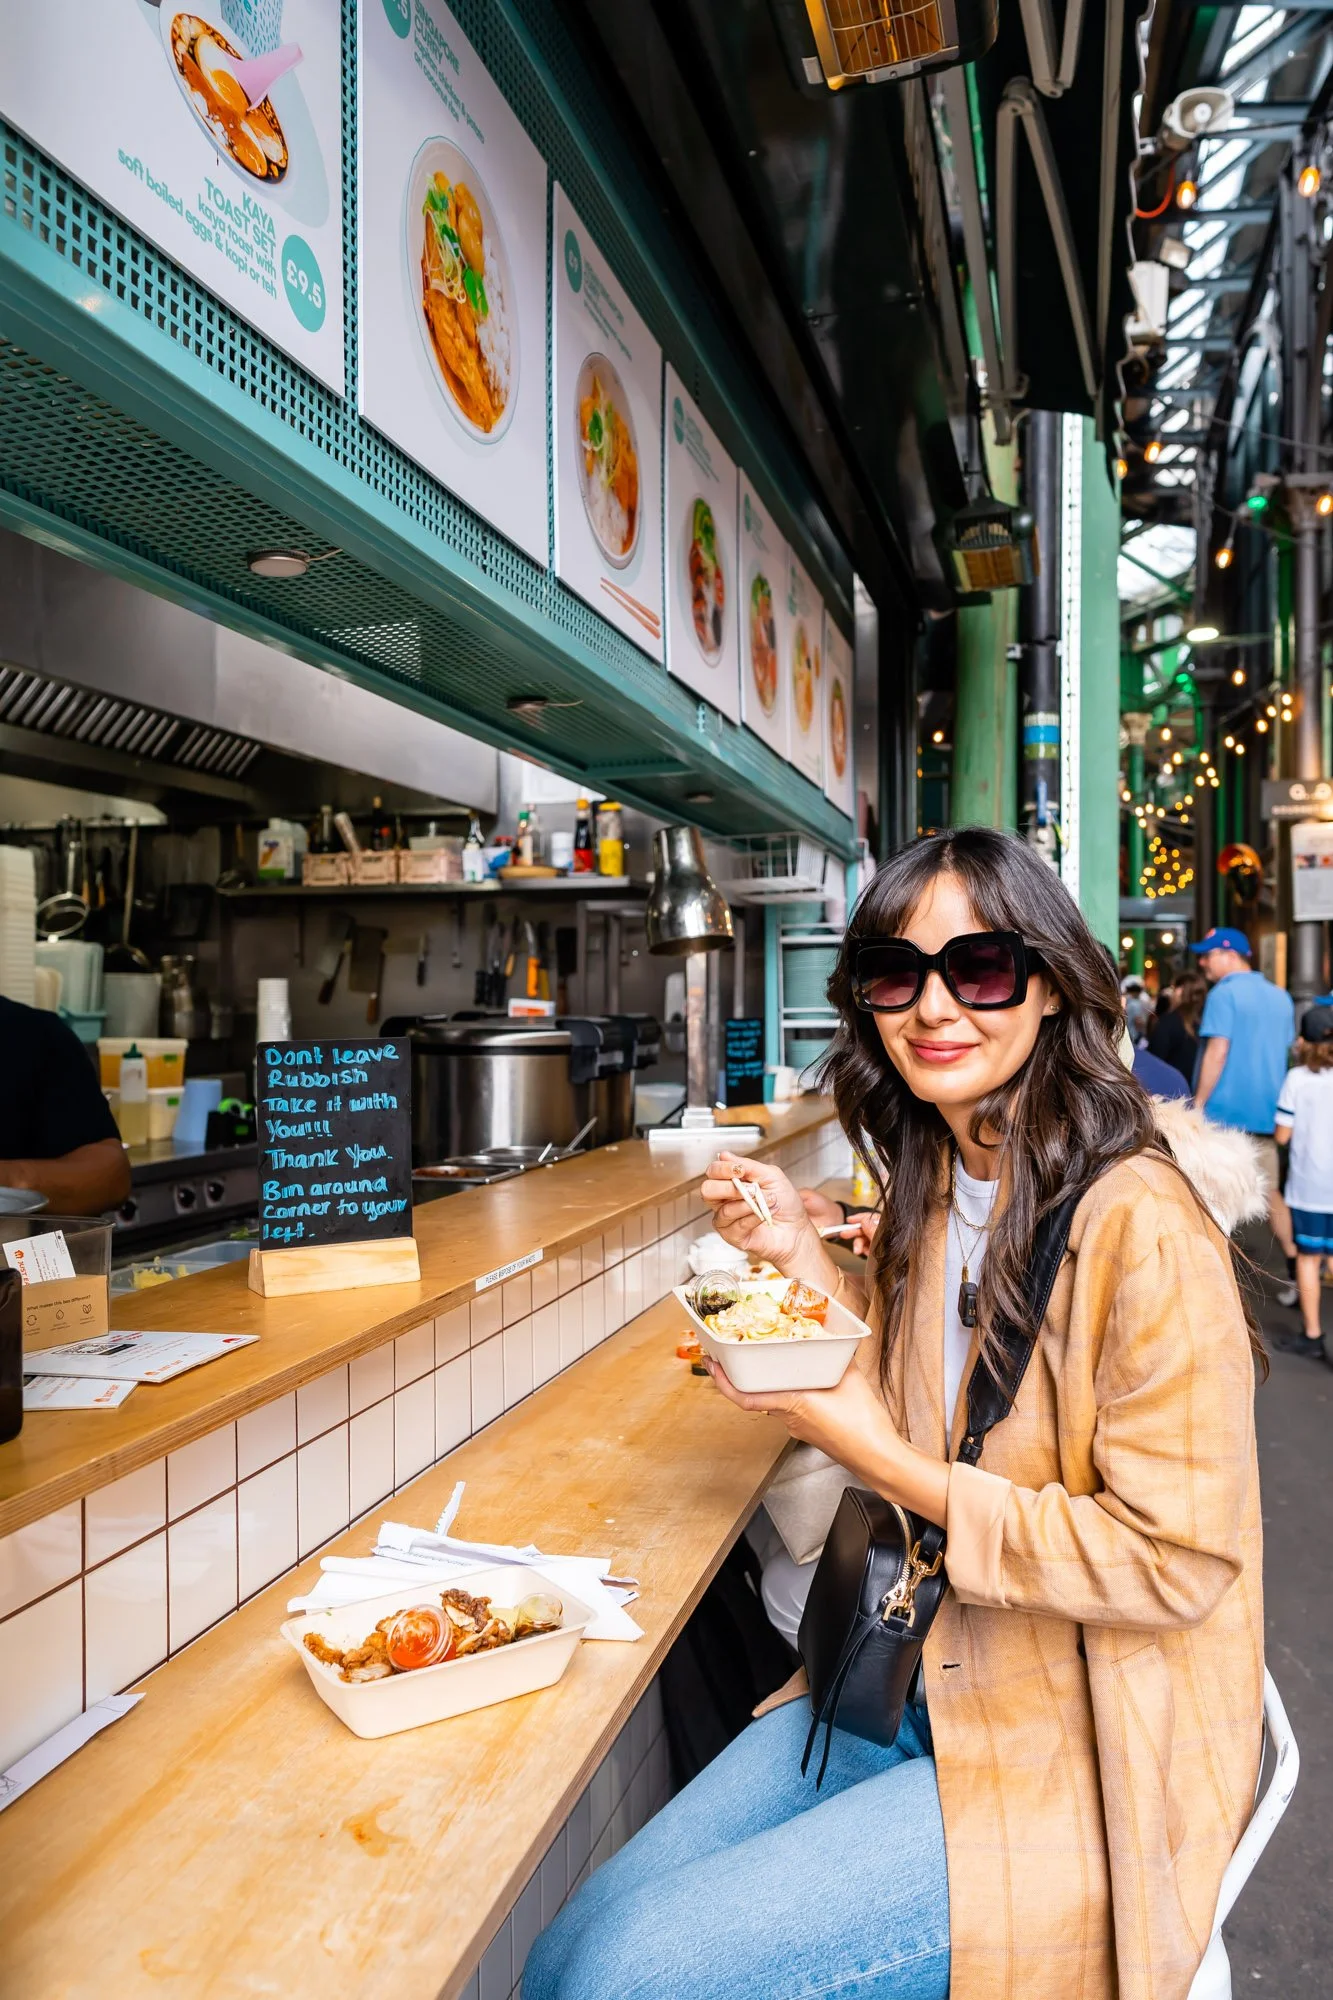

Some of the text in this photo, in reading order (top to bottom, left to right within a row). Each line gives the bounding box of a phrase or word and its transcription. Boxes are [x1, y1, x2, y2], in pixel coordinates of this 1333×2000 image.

[414, 14, 443, 64] CURRY
[414, 51, 459, 122] on coconut rice
[438, 71, 461, 110] chicken
[118, 148, 277, 299] soft boiled eggs & kopi or teh
[204, 177, 276, 259] TOAST SET
[242, 191, 276, 239] KAYA
[198, 193, 277, 280] kaya toast with
[286, 259, 322, 309] £9.5
[264, 1044, 399, 1066] Dont leave
[267, 1068, 369, 1088] Rubbish
[262, 1092, 398, 1113] Take it with
[264, 1148, 339, 1170] Thank
[262, 1176, 389, 1201] Bin around
[336, 1199, 359, 1216] to
[361, 1199, 408, 1222] your
[17, 1261, 28, 1276] JUST
